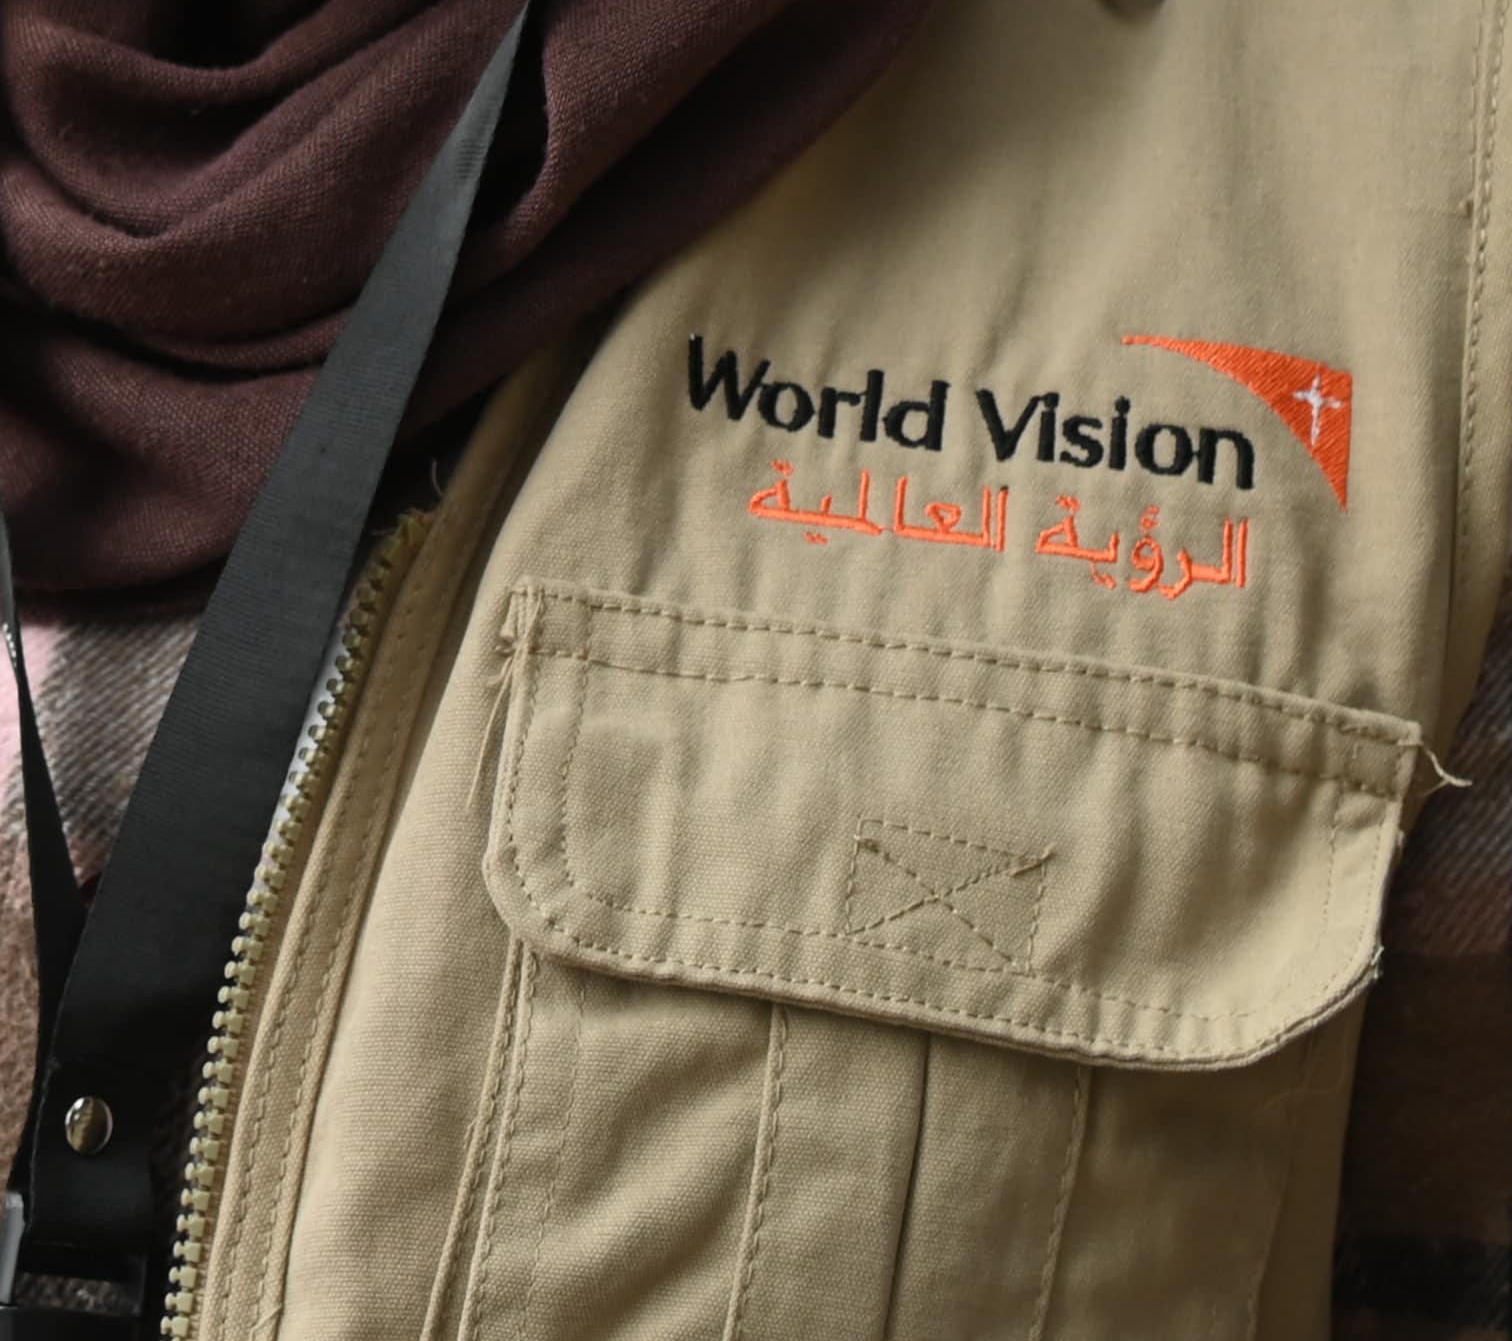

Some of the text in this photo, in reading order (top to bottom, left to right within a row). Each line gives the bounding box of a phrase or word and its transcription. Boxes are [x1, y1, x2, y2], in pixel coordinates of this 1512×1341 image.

[688, 334, 1255, 490] World Vision
[749, 459, 1249, 600] الرؤية العالمية
